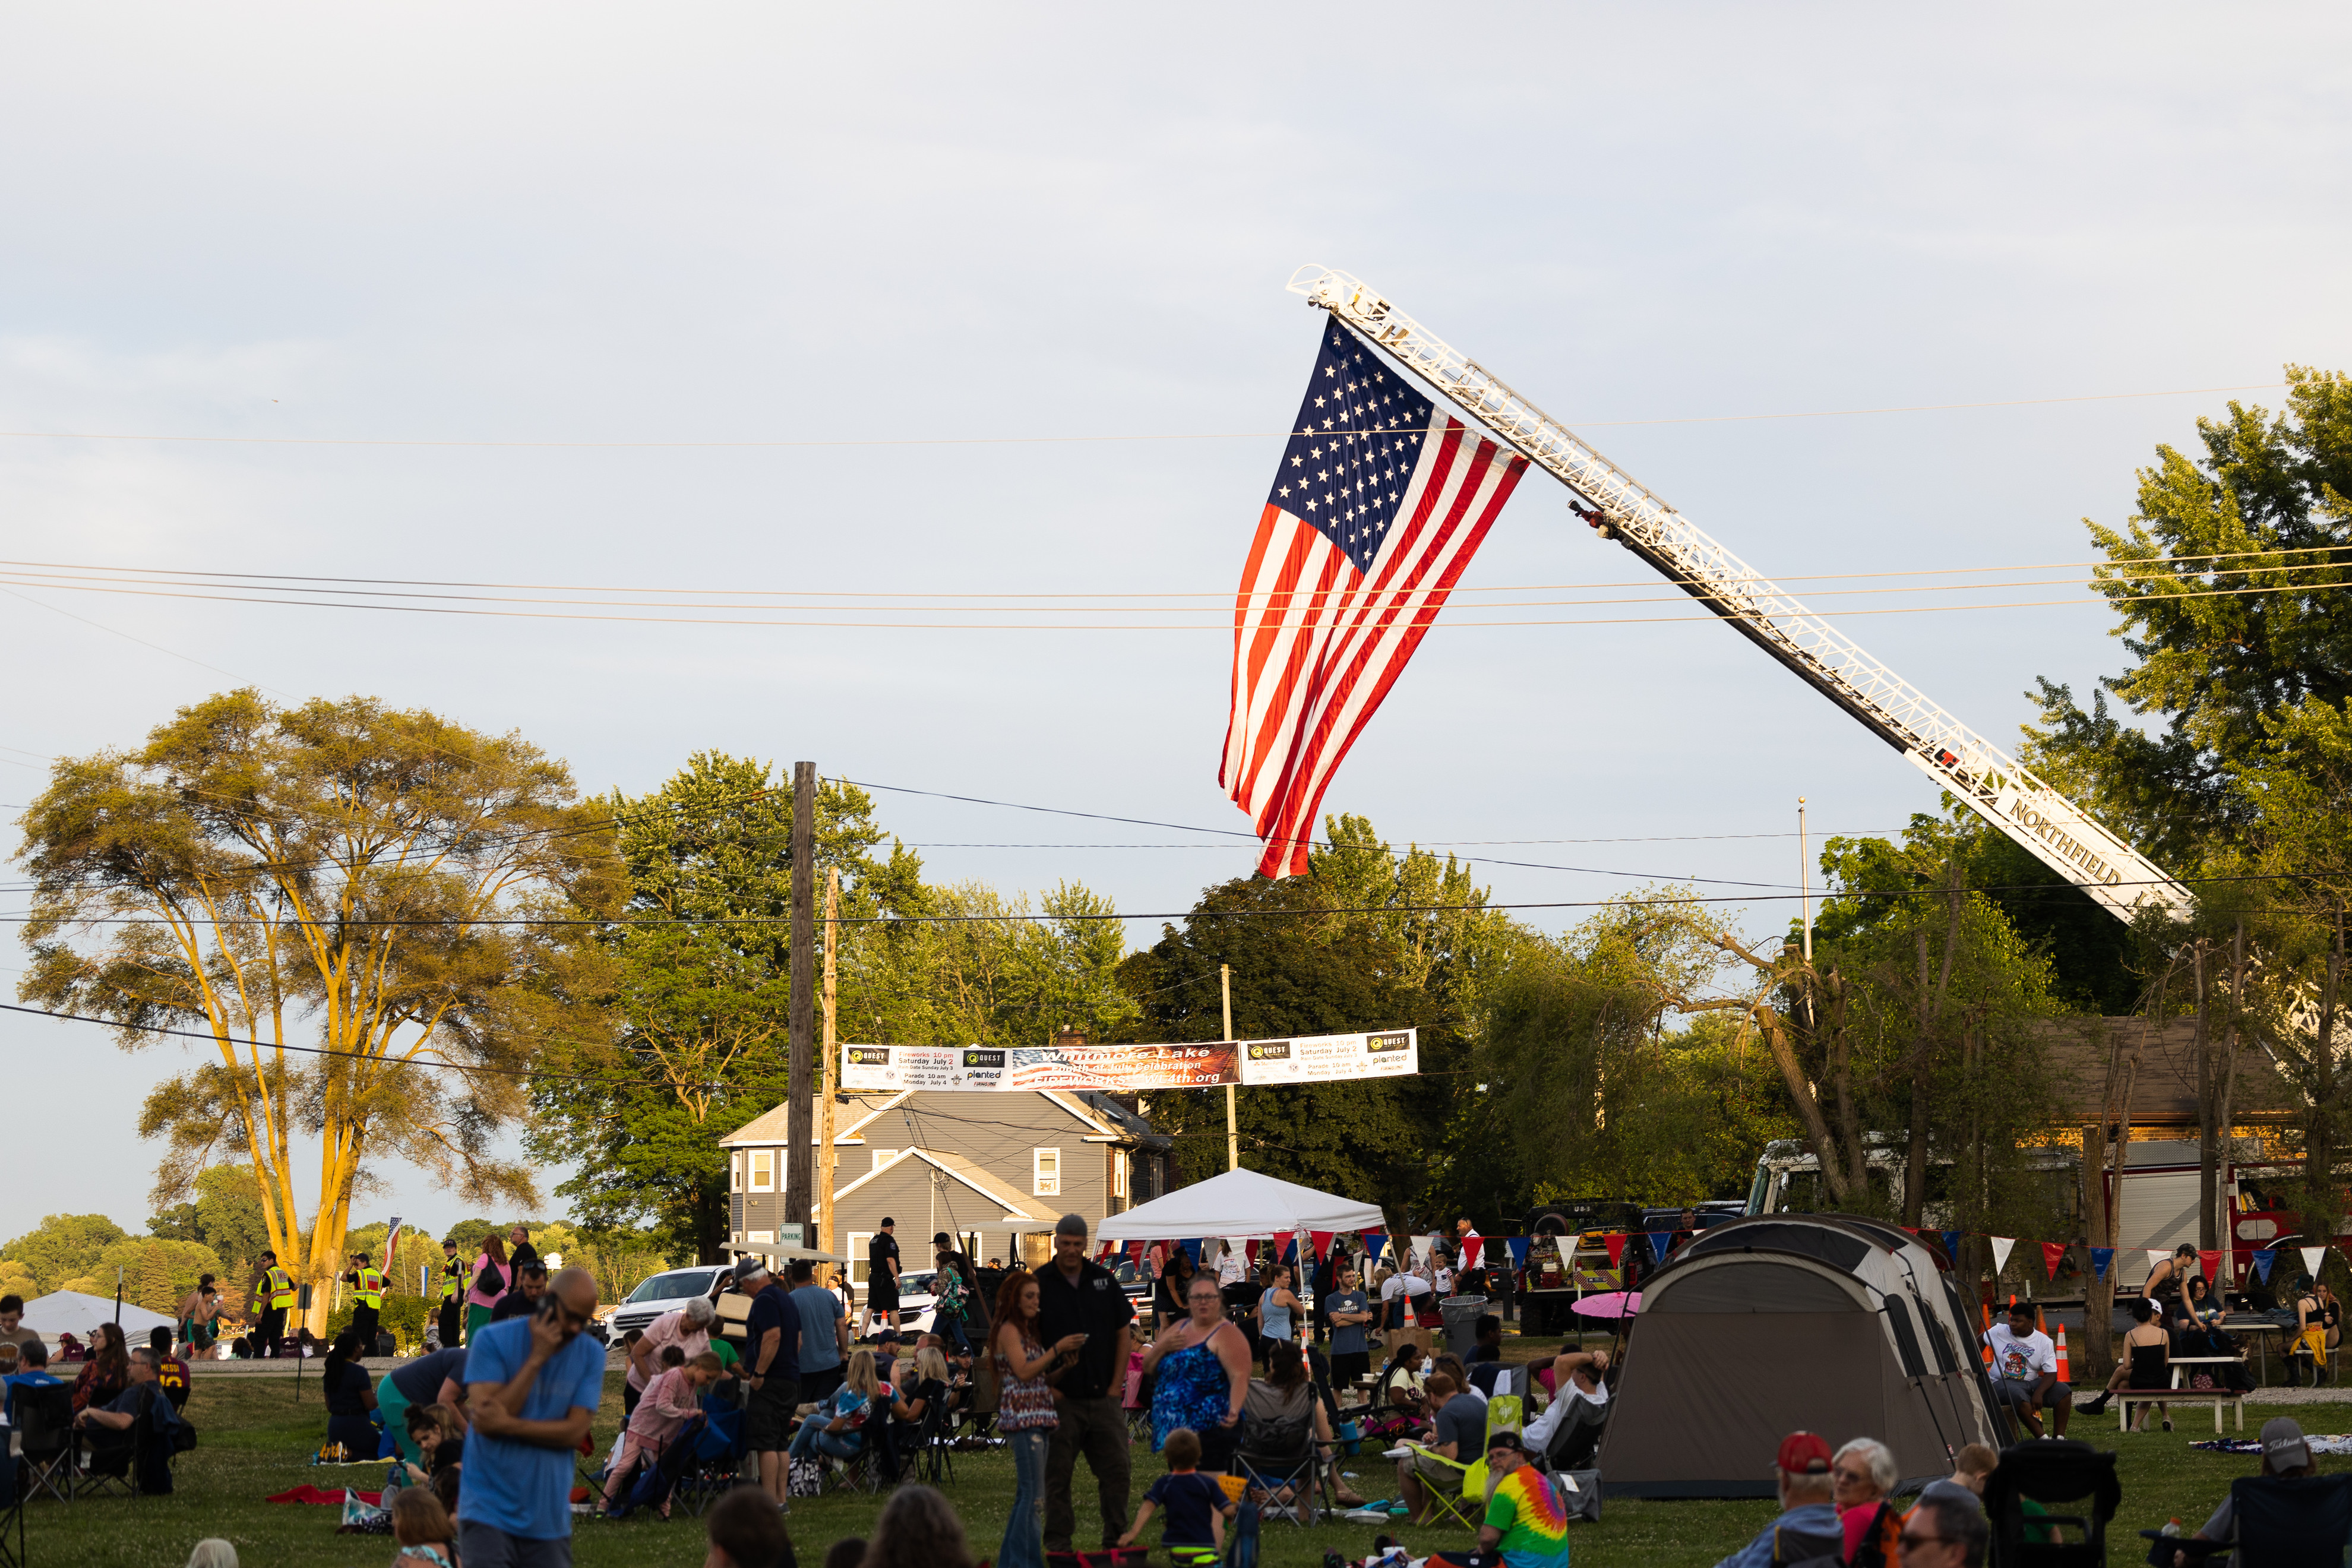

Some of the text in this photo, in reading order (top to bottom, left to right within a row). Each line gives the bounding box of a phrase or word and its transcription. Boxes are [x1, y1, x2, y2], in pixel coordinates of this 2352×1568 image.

[2010, 799, 2121, 888] NORTHFIELD
[1383, 1037, 1405, 1045] QUEST
[1042, 1048, 1210, 1061] Whitmore Lake
[1373, 1052, 1407, 1066] planted
[1051, 1061, 1202, 1073] Fourth of July Celebration
[967, 1070, 1001, 1080] planted
[1033, 1073, 1221, 1087] FIREWORKS WL4th.org
[160, 1363, 179, 1372] MESSI
